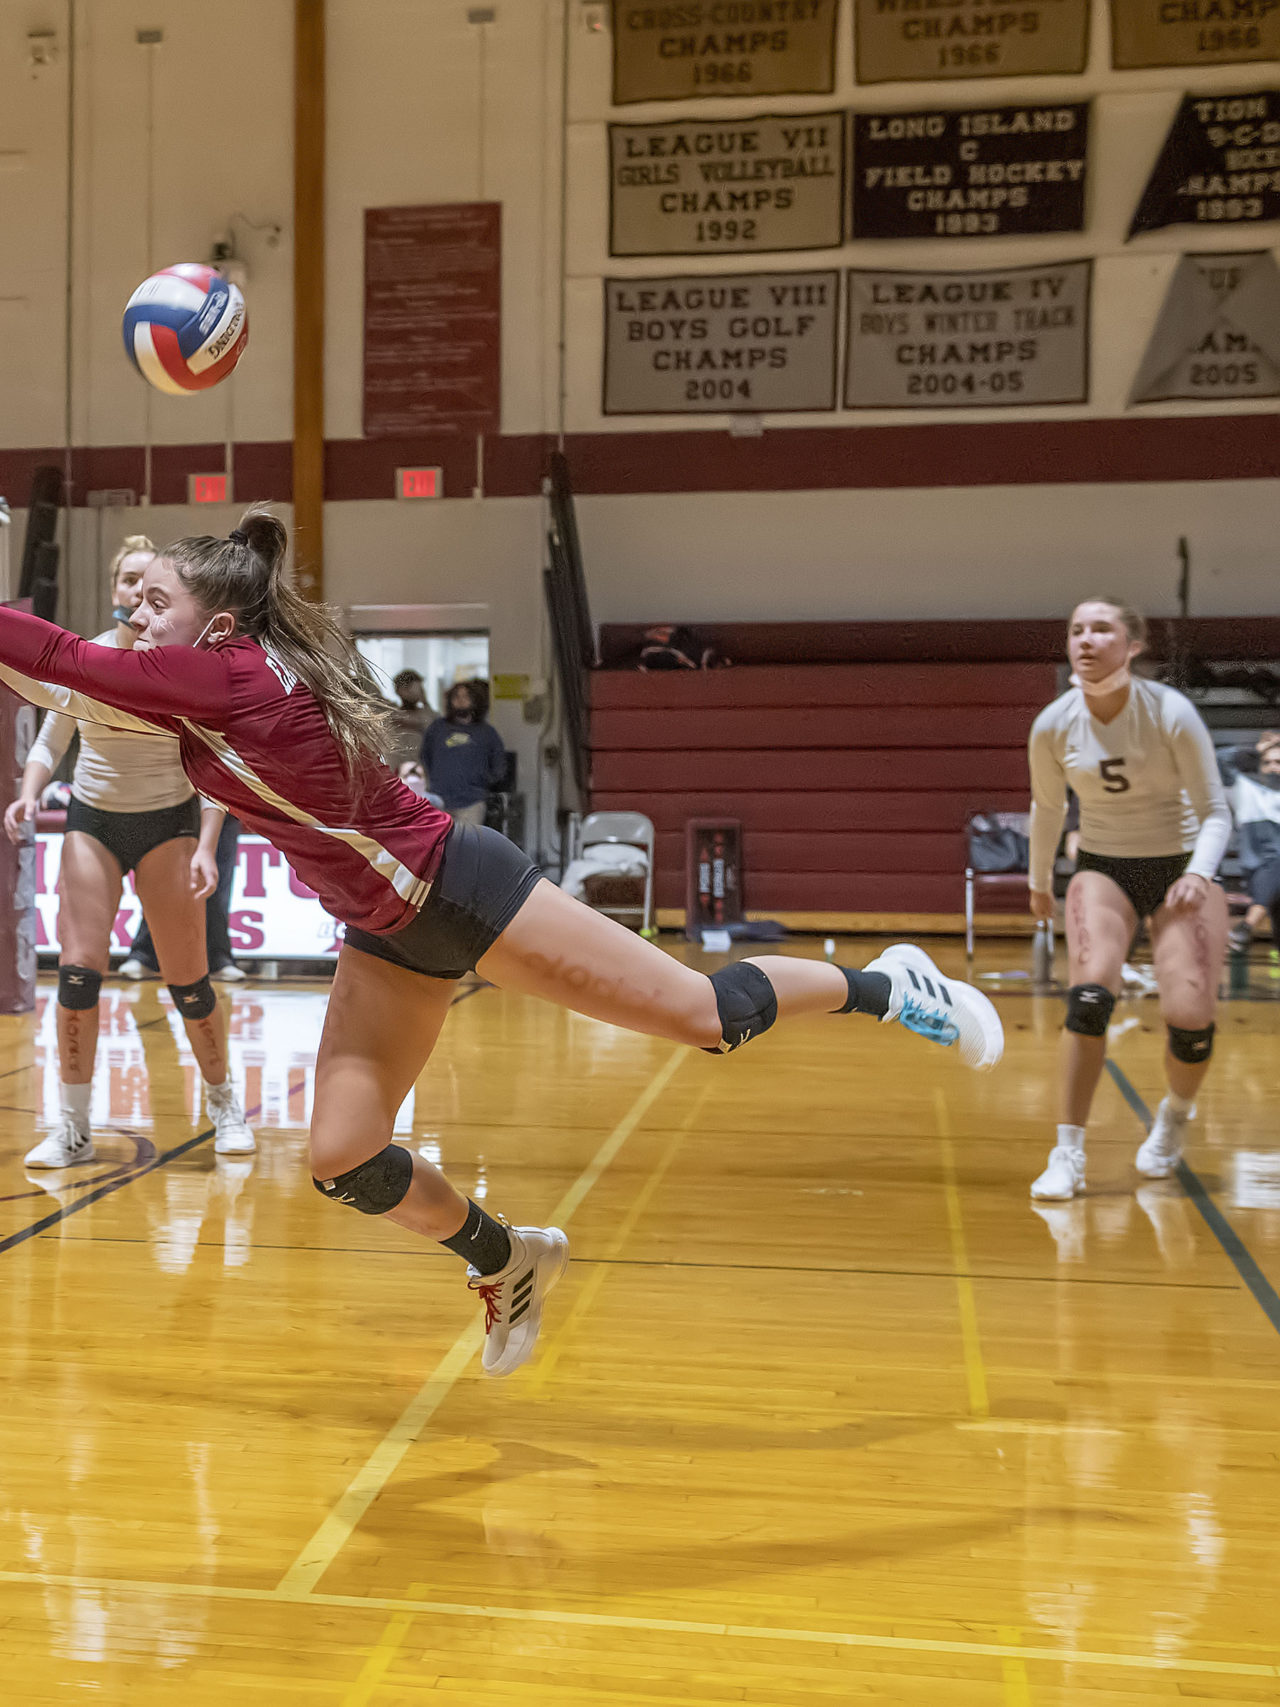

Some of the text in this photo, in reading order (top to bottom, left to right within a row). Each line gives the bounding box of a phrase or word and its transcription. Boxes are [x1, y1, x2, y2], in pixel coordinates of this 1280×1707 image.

[902, 11, 1040, 41] CHAMPS
[1158, 0, 1280, 28] CHAMP
[658, 30, 789, 58] CHAMPS
[868, 109, 1077, 141] LONG ISLAND
[625, 130, 760, 159] LEAGUE
[699, 156, 835, 183] VOLLEYBALL
[865, 158, 1084, 188] FIELD HOCKEY
[660, 187, 794, 214] CHAMPS
[906, 186, 1029, 212] CHAMPS
[695, 218, 757, 242] 1992
[616, 283, 827, 313] LEAGUE VIII
[871, 276, 1066, 305] LEAGUE IV
[627, 313, 816, 342] BOYS GOLF
[652, 346, 788, 371] CHAMPS
[895, 339, 1039, 366] CHAMPS
[906, 373, 1024, 396] 2004-05
[1190, 363, 1260, 387] 2005
[684, 378, 752, 401] 2004
[1099, 758, 1131, 793] 5
